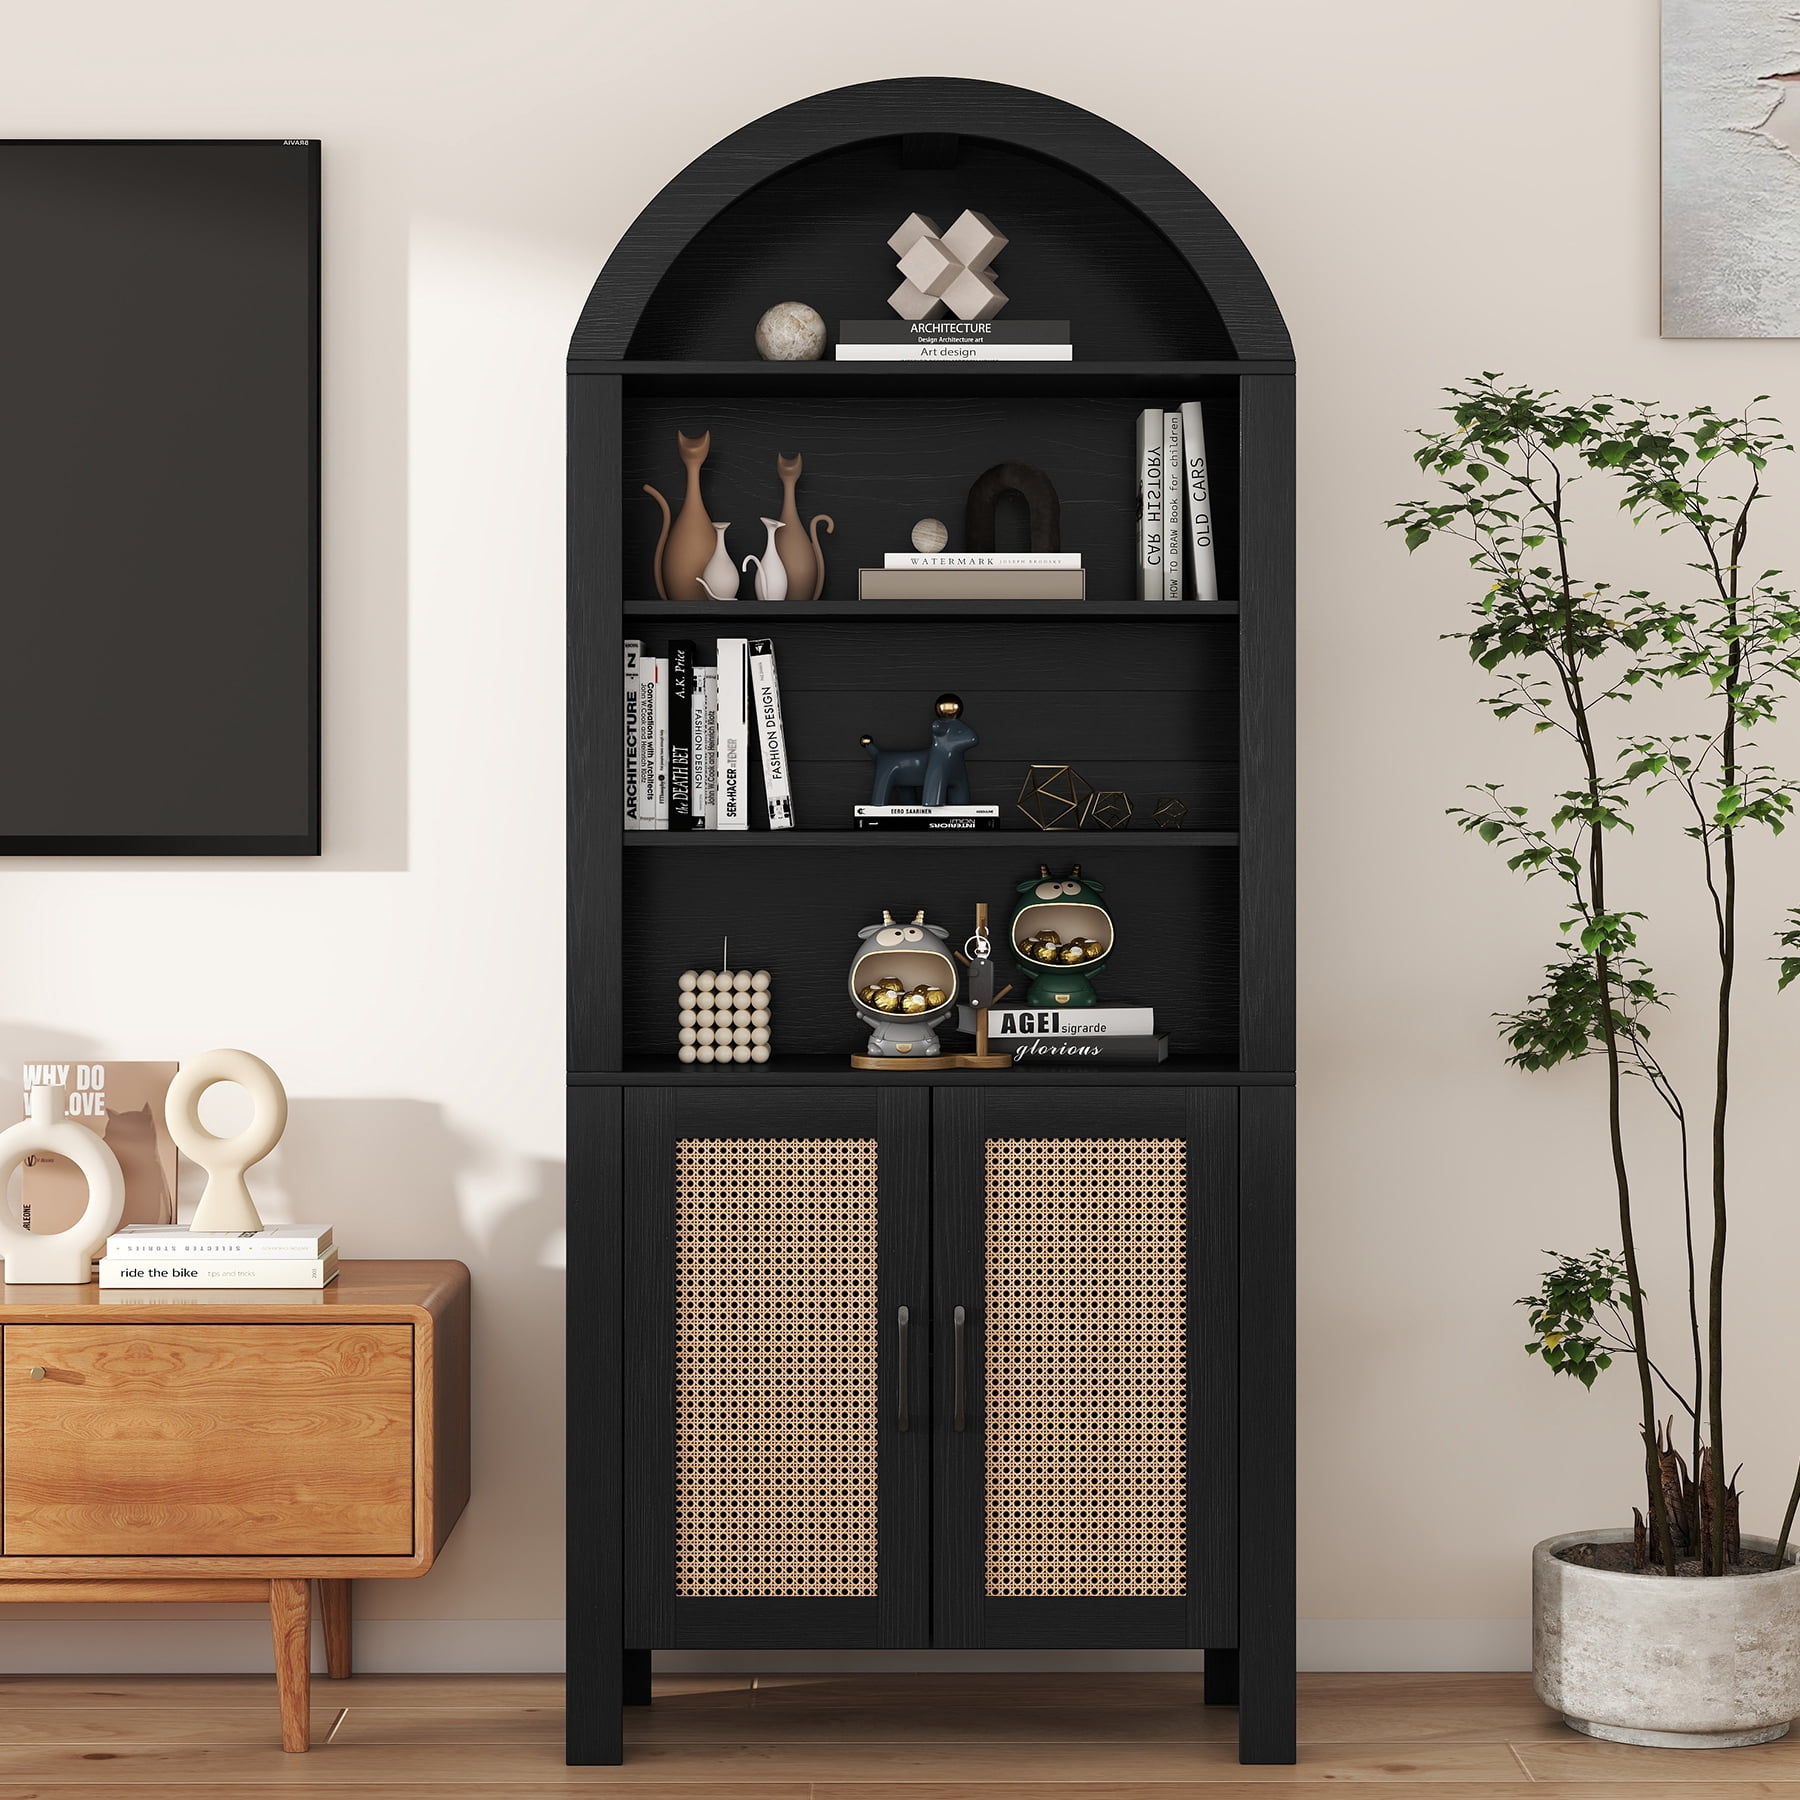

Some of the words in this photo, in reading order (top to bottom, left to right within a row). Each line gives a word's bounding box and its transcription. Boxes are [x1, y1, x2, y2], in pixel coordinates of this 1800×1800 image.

[910, 322, 992, 333] ARCHITECTURE
[918, 336, 937, 344] Design
[920, 347, 937, 357] Art
[940, 347, 976, 359] design
[1170, 417, 1178, 468] children
[1170, 474, 1178, 491] for
[1190, 457, 1207, 502] CARS
[1170, 498, 1178, 524] Book
[1170, 529, 1178, 554] DRAW
[1195, 513, 1211, 547] OLD
[910, 557, 995, 566] WATERMARK
[1170, 560, 1178, 574] TO
[1170, 579, 1178, 599] HOW
[674, 649, 685, 672] Price
[762, 686, 777, 728] DESIGN
[695, 709, 703, 751] FASHION
[626, 691, 637, 820] ARCHITECTURE
[672, 745, 689, 764] BET
[767, 730, 782, 780] FASHION
[672, 766, 689, 801] DEATH
[695, 754, 703, 789] DESIGN
[676, 802, 688, 814] the
[1000, 1012, 1059, 1034] AGEI
[1061, 1023, 1107, 1035] sigrarde
[1013, 1038, 1103, 1062] glorious
[23, 1064, 70, 1091] WHY
[77, 1064, 105, 1091] DO
[64, 1092, 105, 1116] OVE
[120, 1267, 145, 1278] ride
[148, 1267, 169, 1278] the
[172, 1267, 198, 1278] bike
